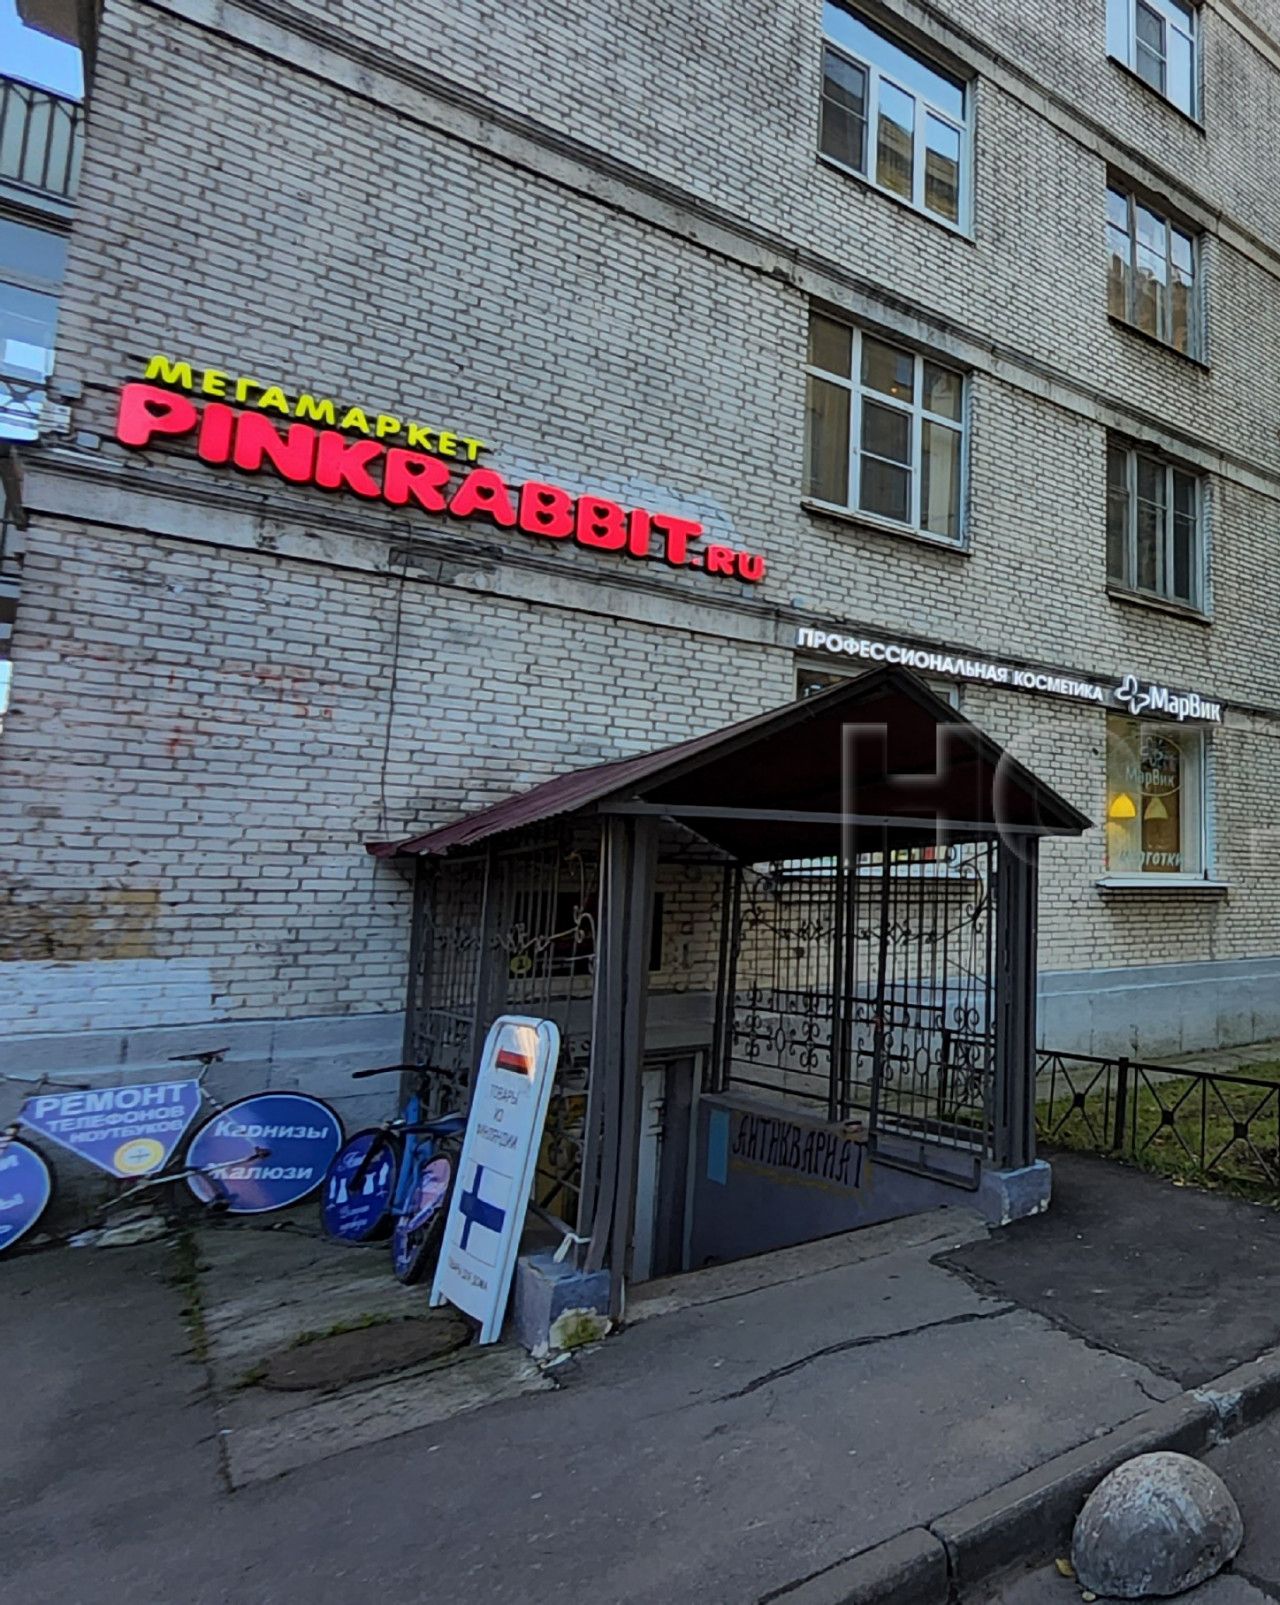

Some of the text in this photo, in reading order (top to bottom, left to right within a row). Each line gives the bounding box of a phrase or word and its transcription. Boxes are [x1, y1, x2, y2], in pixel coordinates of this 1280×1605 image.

[144, 355, 486, 462] МЕГАМАРКЕТ
[115, 383, 768, 583] PINKRABBIT.RU
[797, 627, 1104, 702] ПРОФЕССИОНАЛЬНАЯ КОСМЕТИКА
[1148, 685, 1221, 722] МарВик
[34, 1083, 188, 1119] РЕМОНТ
[46, 1104, 185, 1133] ТЕЛЕФОНОВ
[69, 1119, 184, 1144] НОУТБУКОВ
[214, 1120, 329, 1139] Карнизы
[732, 1114, 868, 1189] АНТИКВАРИАТ
